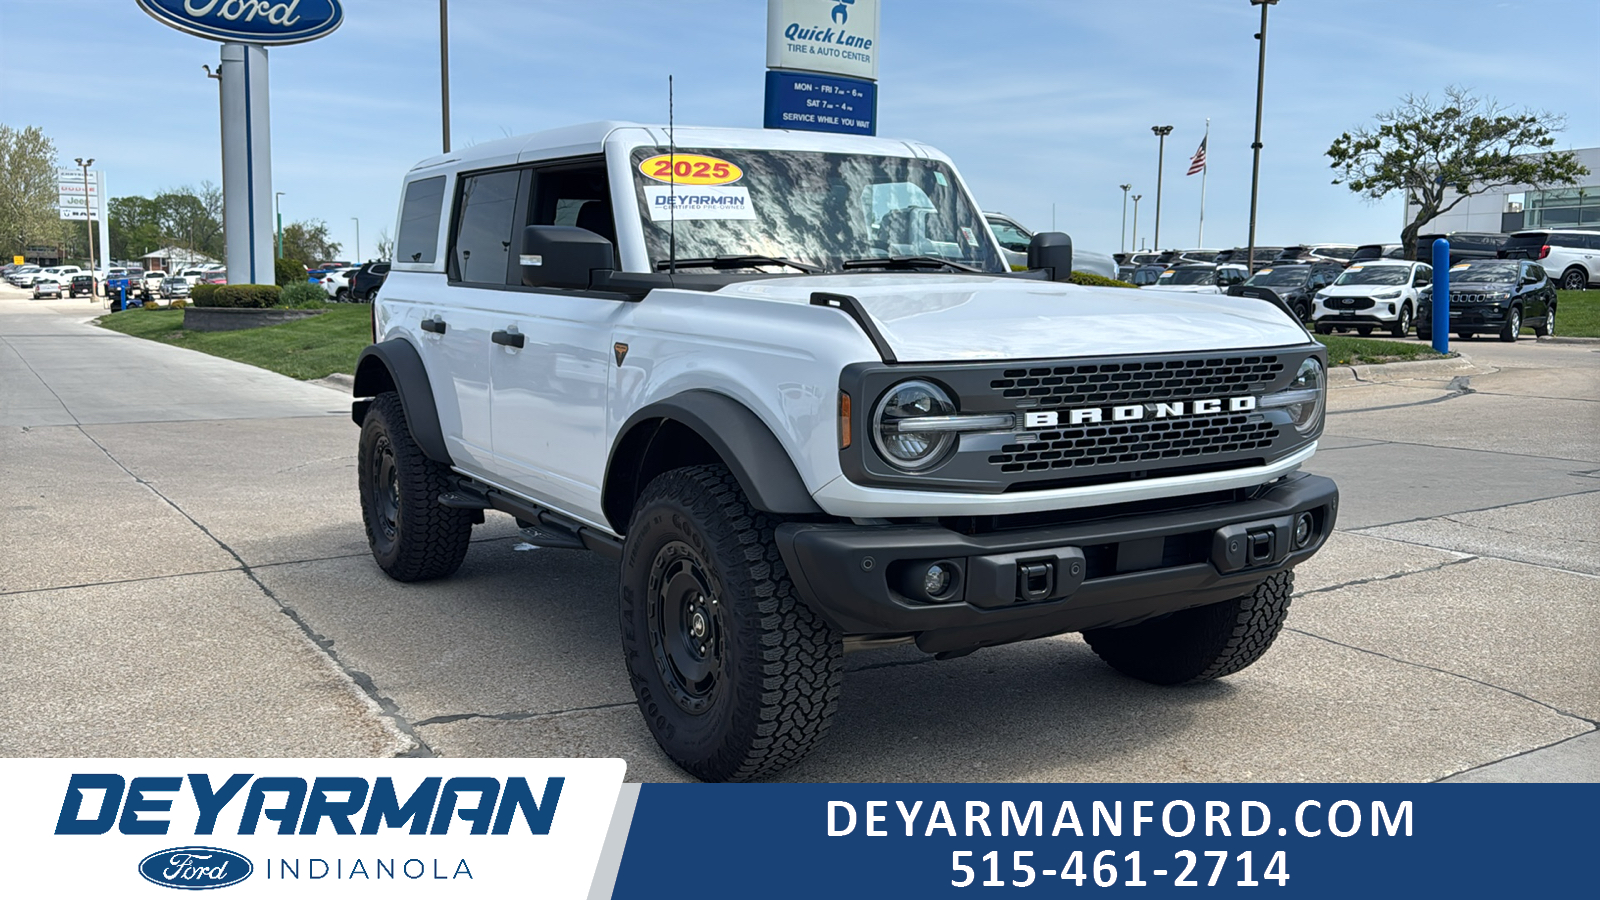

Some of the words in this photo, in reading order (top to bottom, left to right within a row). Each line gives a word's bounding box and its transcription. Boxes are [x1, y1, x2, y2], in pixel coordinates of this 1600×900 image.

[784, 23, 835, 44] Quick
[836, 30, 873, 50] Lane
[787, 43, 807, 53] TIRE
[809, 46, 815, 54] &
[817, 47, 840, 58] AUTO
[841, 50, 871, 63] CENTER
[794, 82, 813, 91] MON
[821, 85, 833, 93] FRI
[806, 98, 820, 108] SAT
[782, 112, 815, 122] SERVICE
[817, 115, 839, 125] WHILE
[841, 118, 855, 127] YOU
[856, 119, 871, 129] WAIT
[653, 160, 731, 179] 2025
[655, 195, 745, 205] DEYARMAN
[1024, 396, 1256, 428] BRONCO
